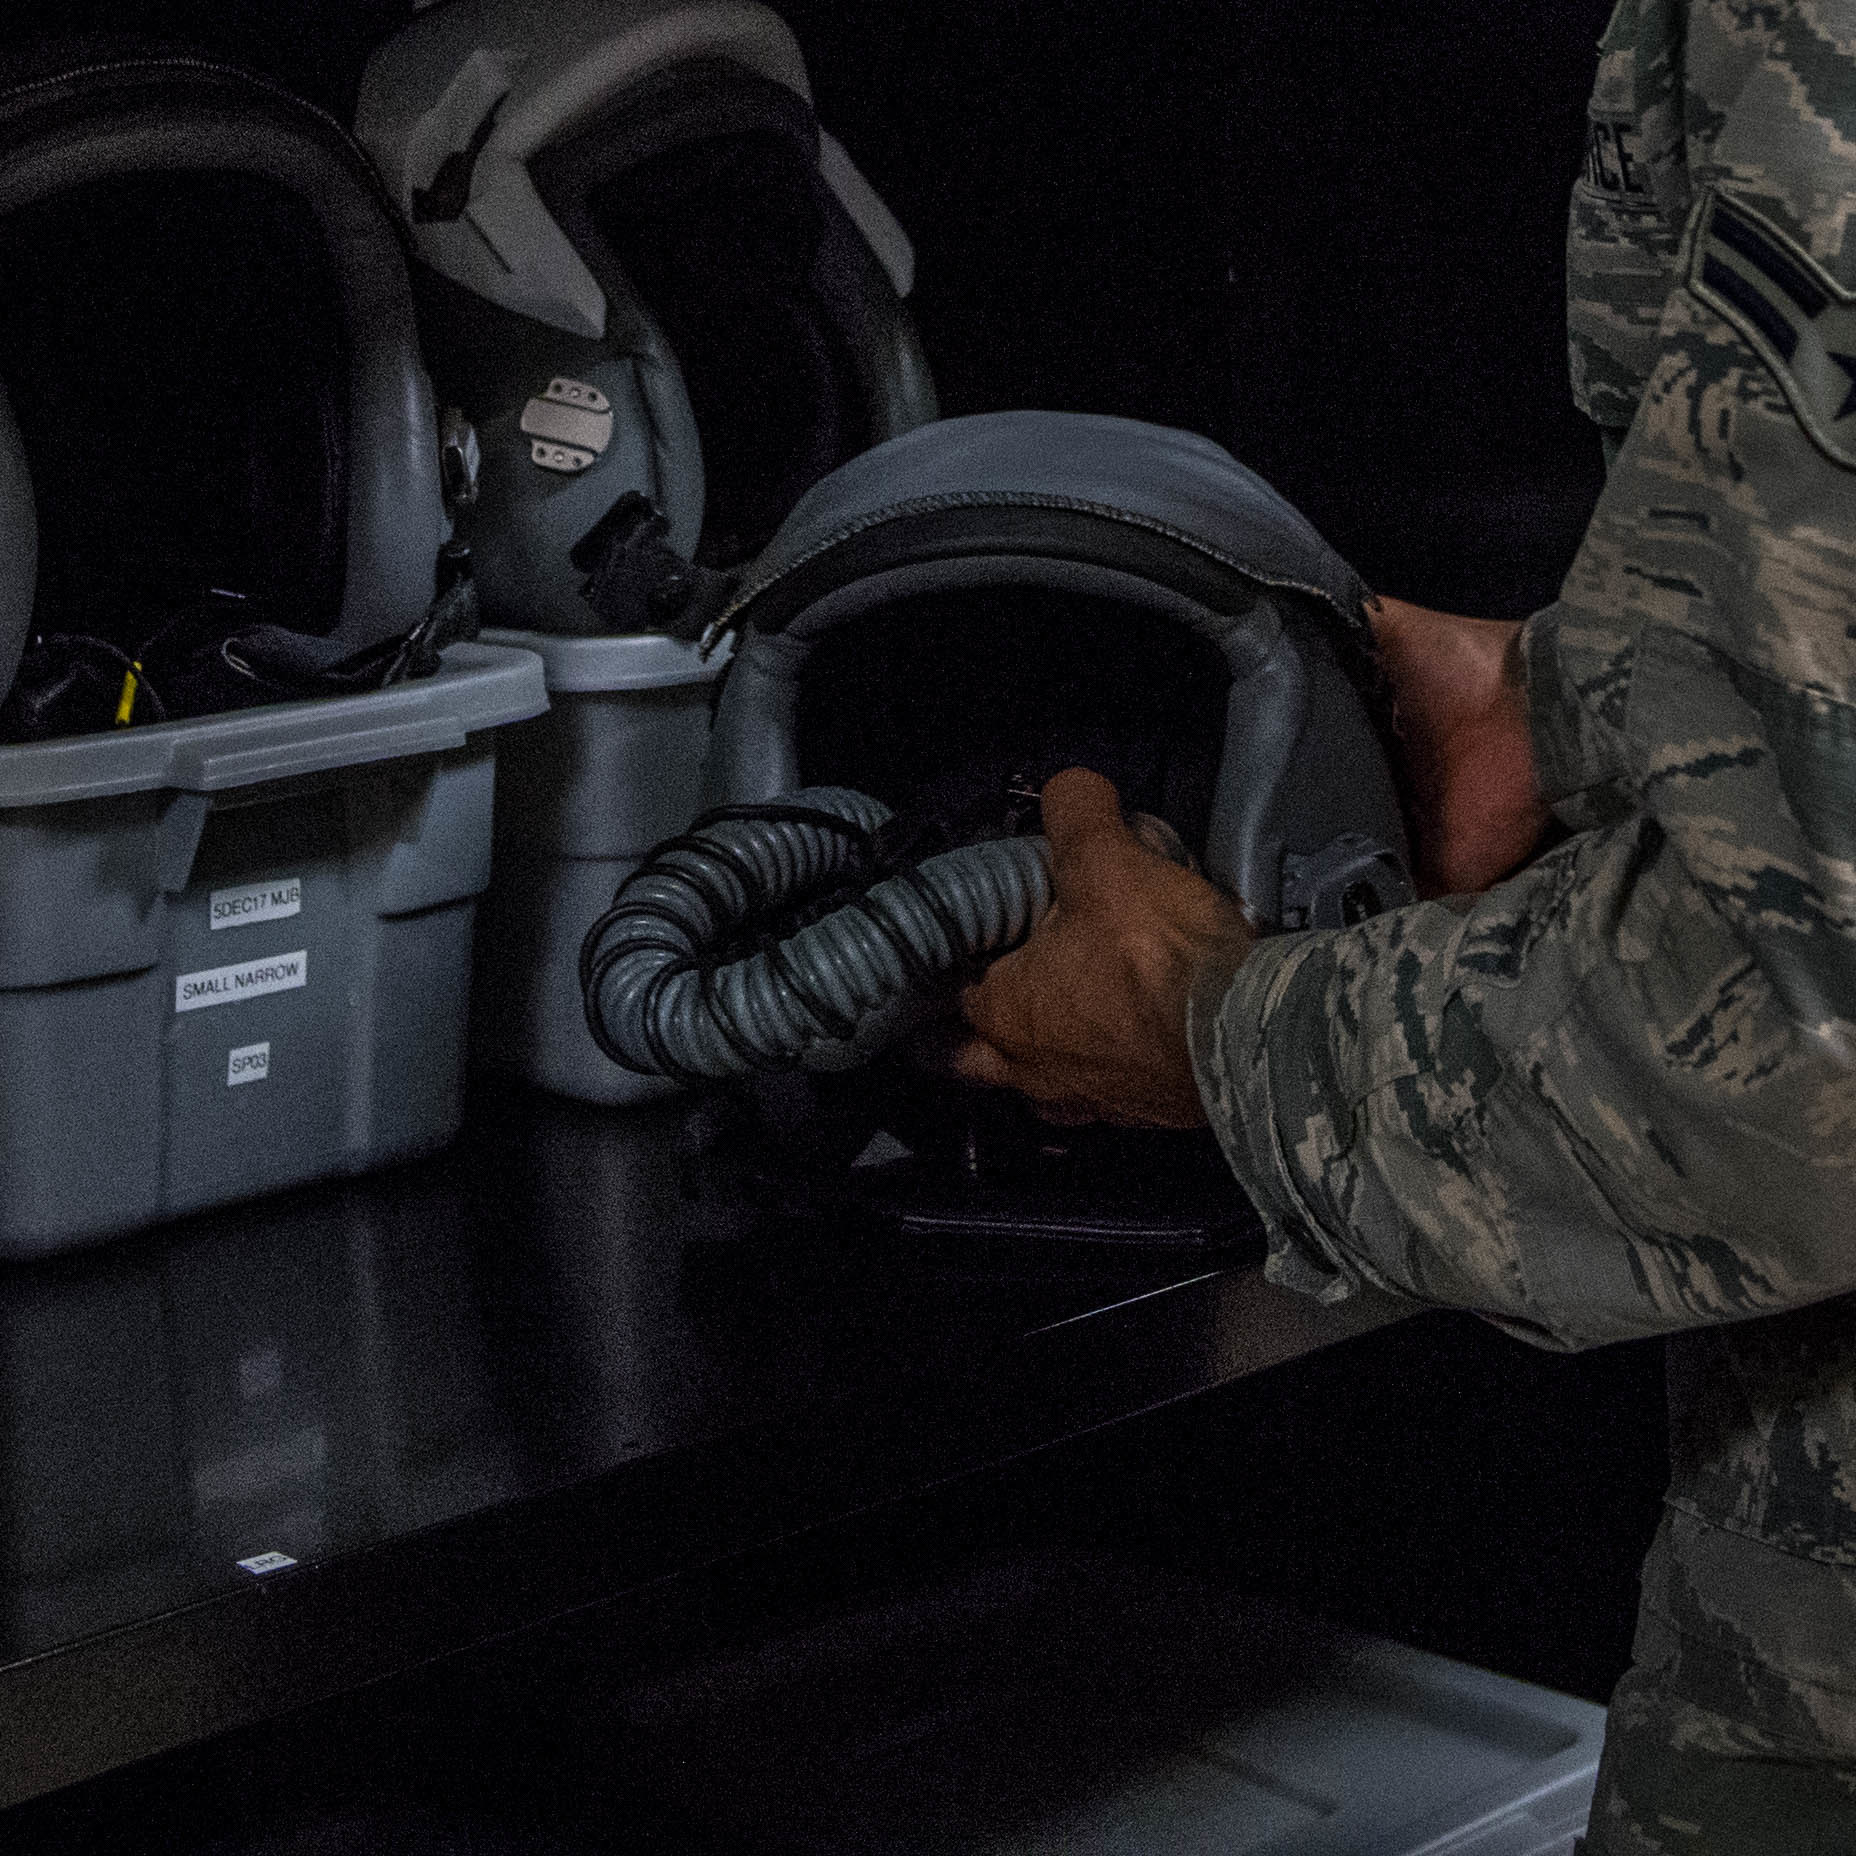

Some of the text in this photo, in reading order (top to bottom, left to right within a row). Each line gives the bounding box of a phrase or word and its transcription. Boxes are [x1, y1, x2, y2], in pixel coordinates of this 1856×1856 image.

[213, 893, 267, 921] 5DEC17
[181, 962, 300, 1001] SMALL NARROW
